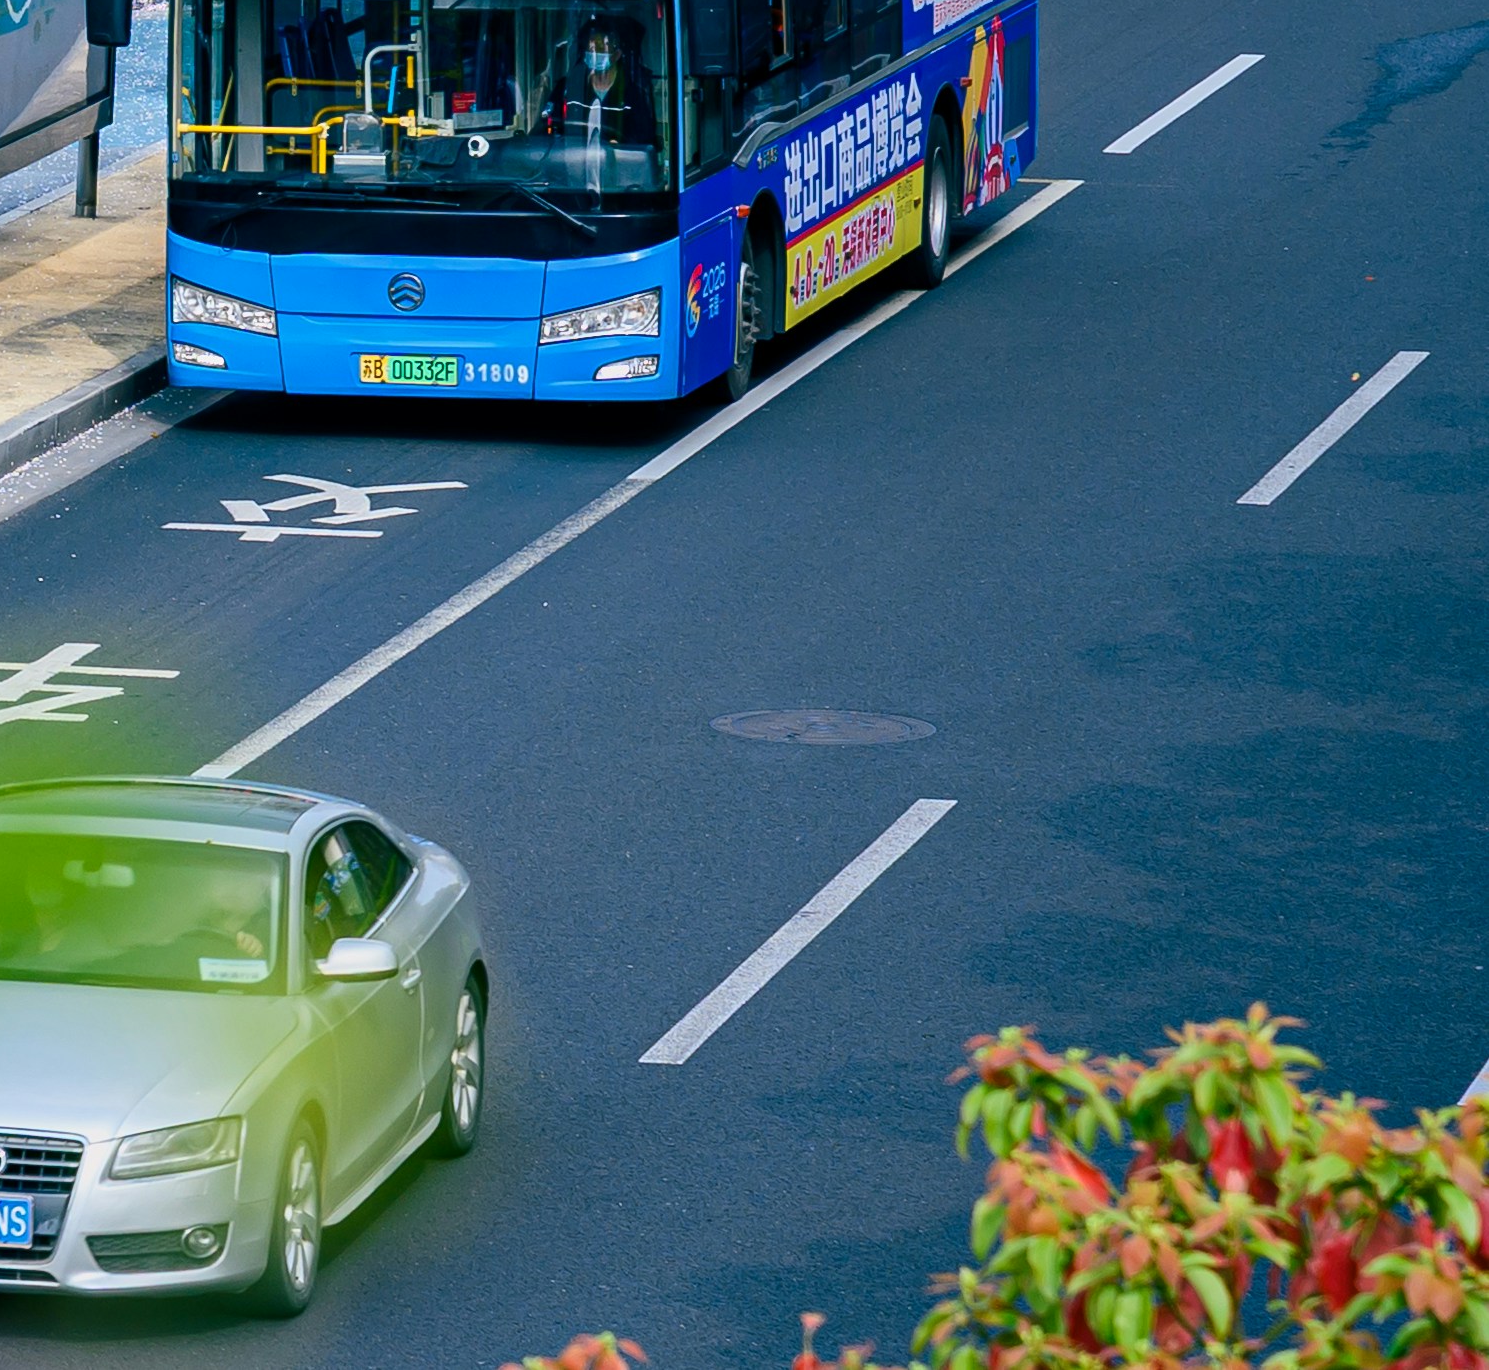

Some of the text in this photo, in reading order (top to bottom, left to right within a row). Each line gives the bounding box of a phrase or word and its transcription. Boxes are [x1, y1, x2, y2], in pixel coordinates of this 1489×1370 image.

[784, 72, 923, 238] 进出口商品博览会
[702, 261, 726, 298] 2026
[465, 363, 529, 384] 31809
